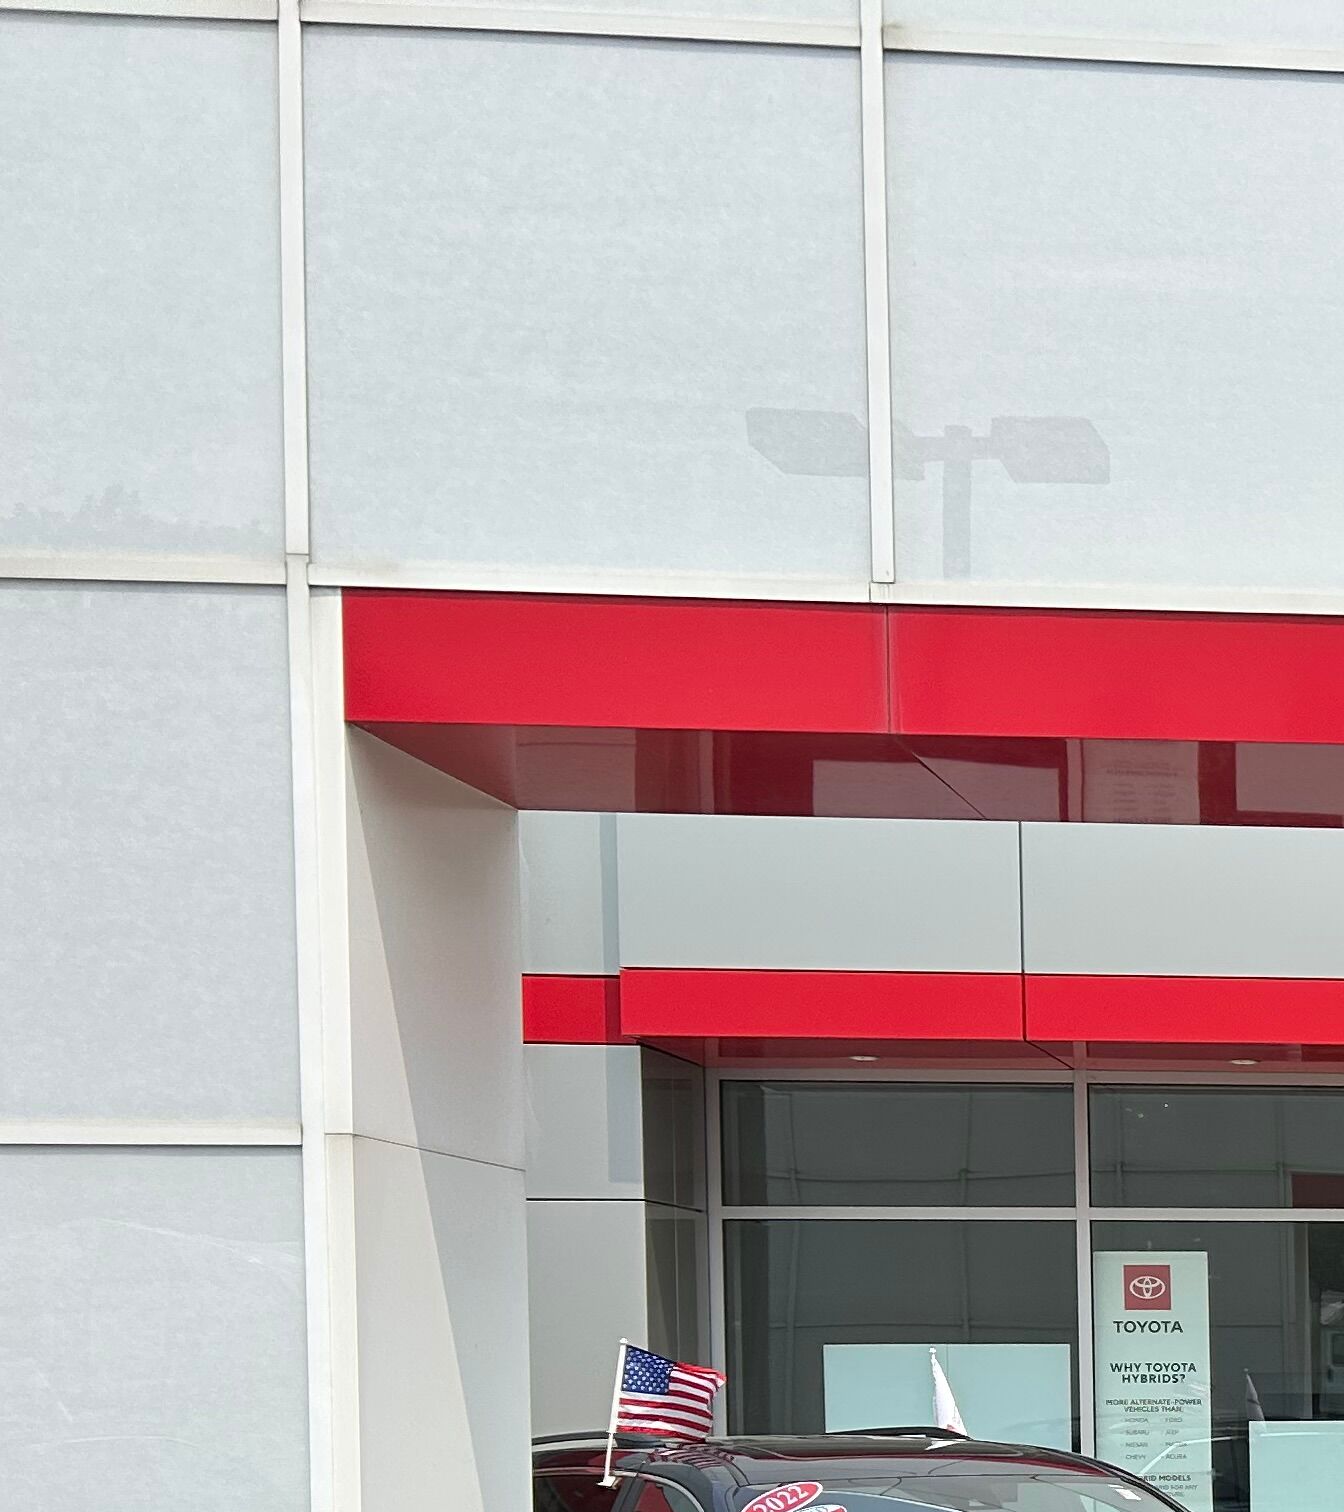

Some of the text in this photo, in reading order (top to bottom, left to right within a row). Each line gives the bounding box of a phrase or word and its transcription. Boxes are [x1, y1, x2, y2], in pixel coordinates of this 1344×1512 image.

[1112, 1320, 1184, 1334] TOYOTA
[1109, 1362, 1197, 1373] WHY TOYOTA
[1121, 1373, 1187, 1384] HYBRIDS?
